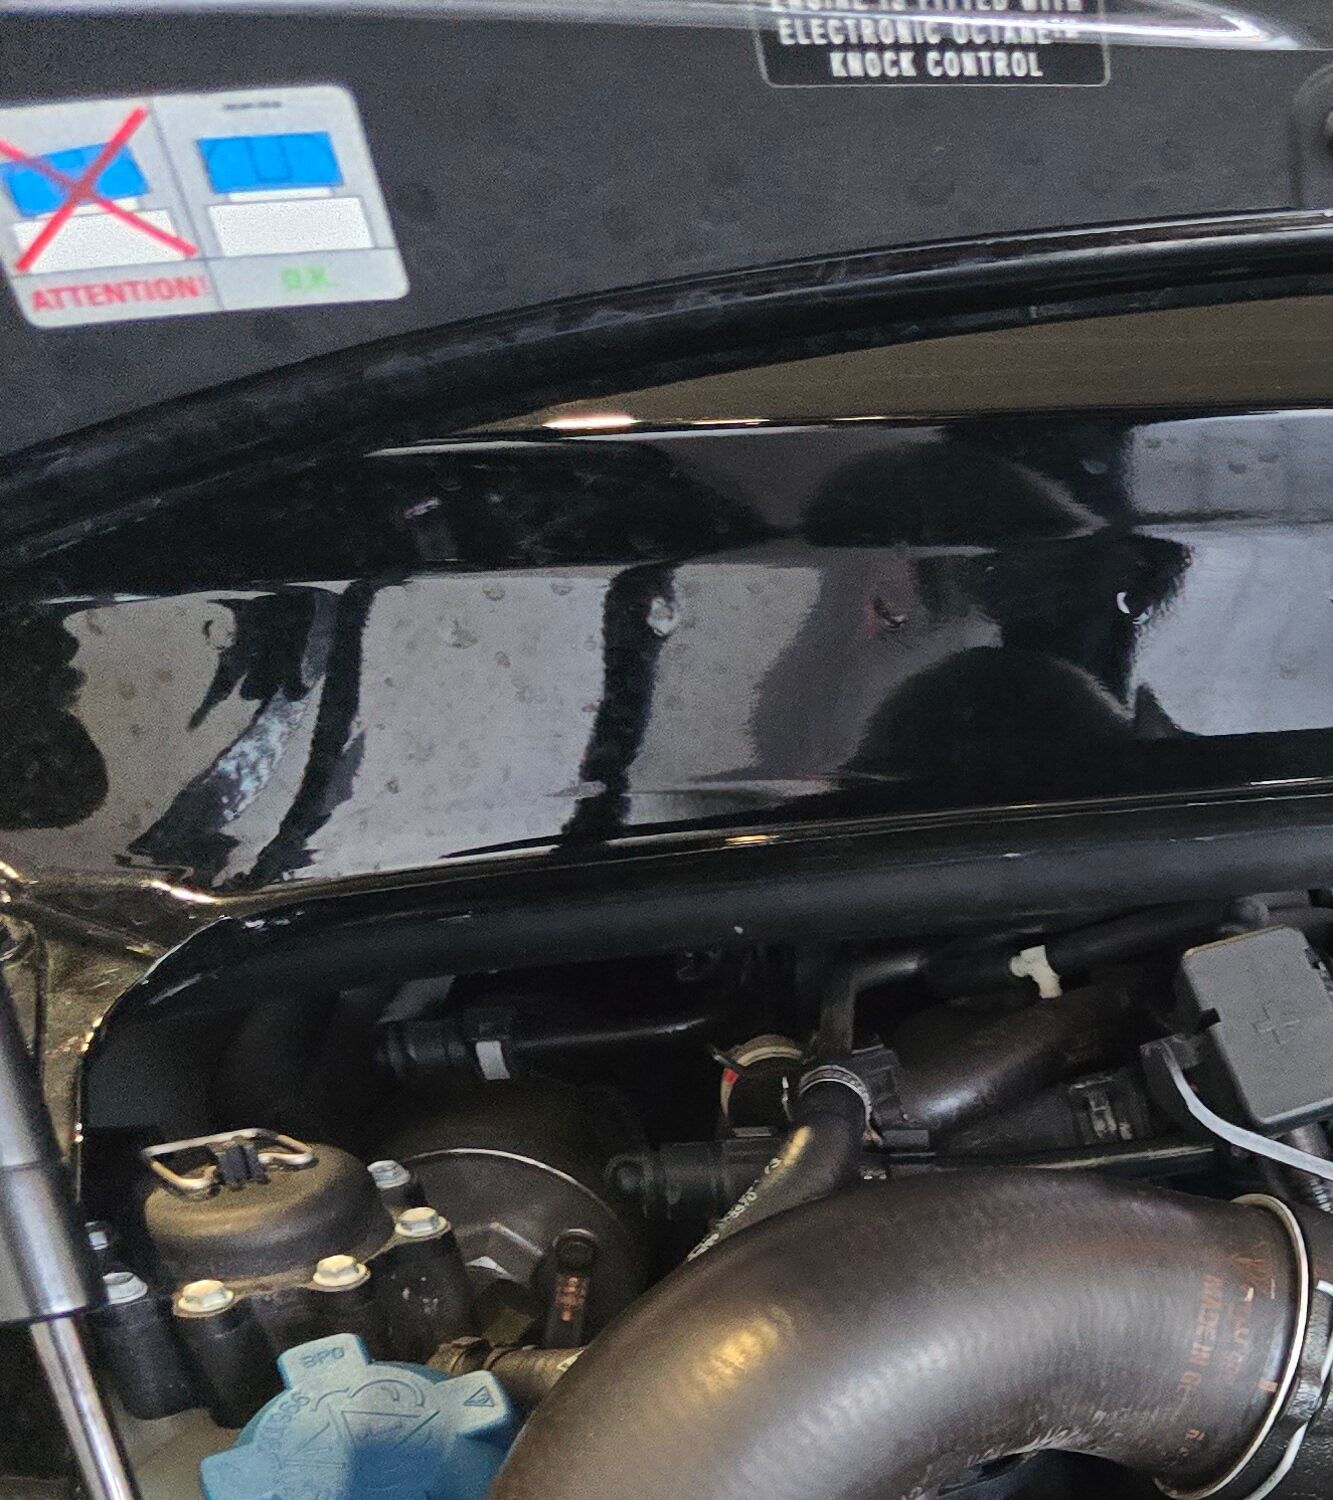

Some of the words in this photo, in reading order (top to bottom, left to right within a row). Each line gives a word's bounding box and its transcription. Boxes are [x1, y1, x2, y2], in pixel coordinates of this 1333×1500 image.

[777, 18, 942, 45] ELECTRONIC
[829, 51, 917, 77] KNOCK
[926, 51, 1044, 77] CONTROL
[32, 274, 208, 312] ATTENTION!
